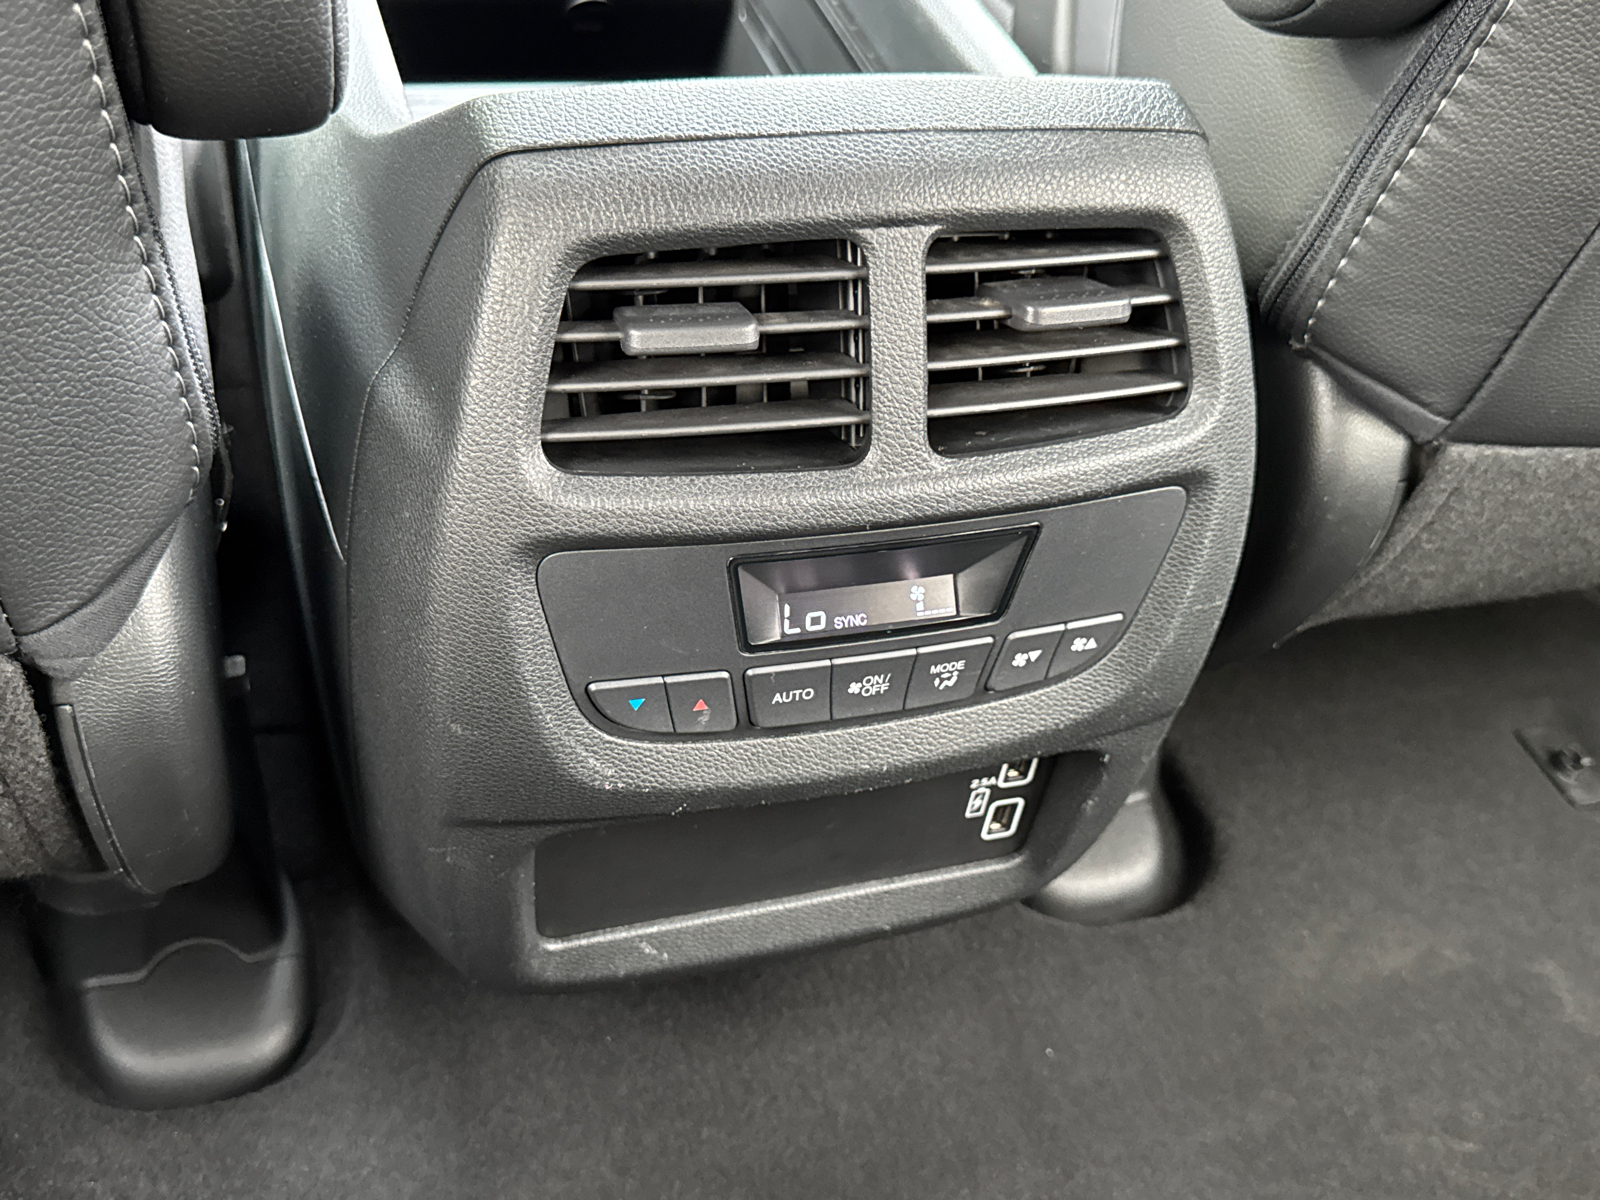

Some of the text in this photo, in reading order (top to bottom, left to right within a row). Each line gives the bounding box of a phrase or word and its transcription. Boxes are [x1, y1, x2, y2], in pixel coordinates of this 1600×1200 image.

[833, 612, 868, 629] SYNC
[929, 660, 966, 675] MODE
[862, 672, 892, 687] ON/
[771, 687, 815, 705] AUTO
[861, 682, 890, 697] OFF
